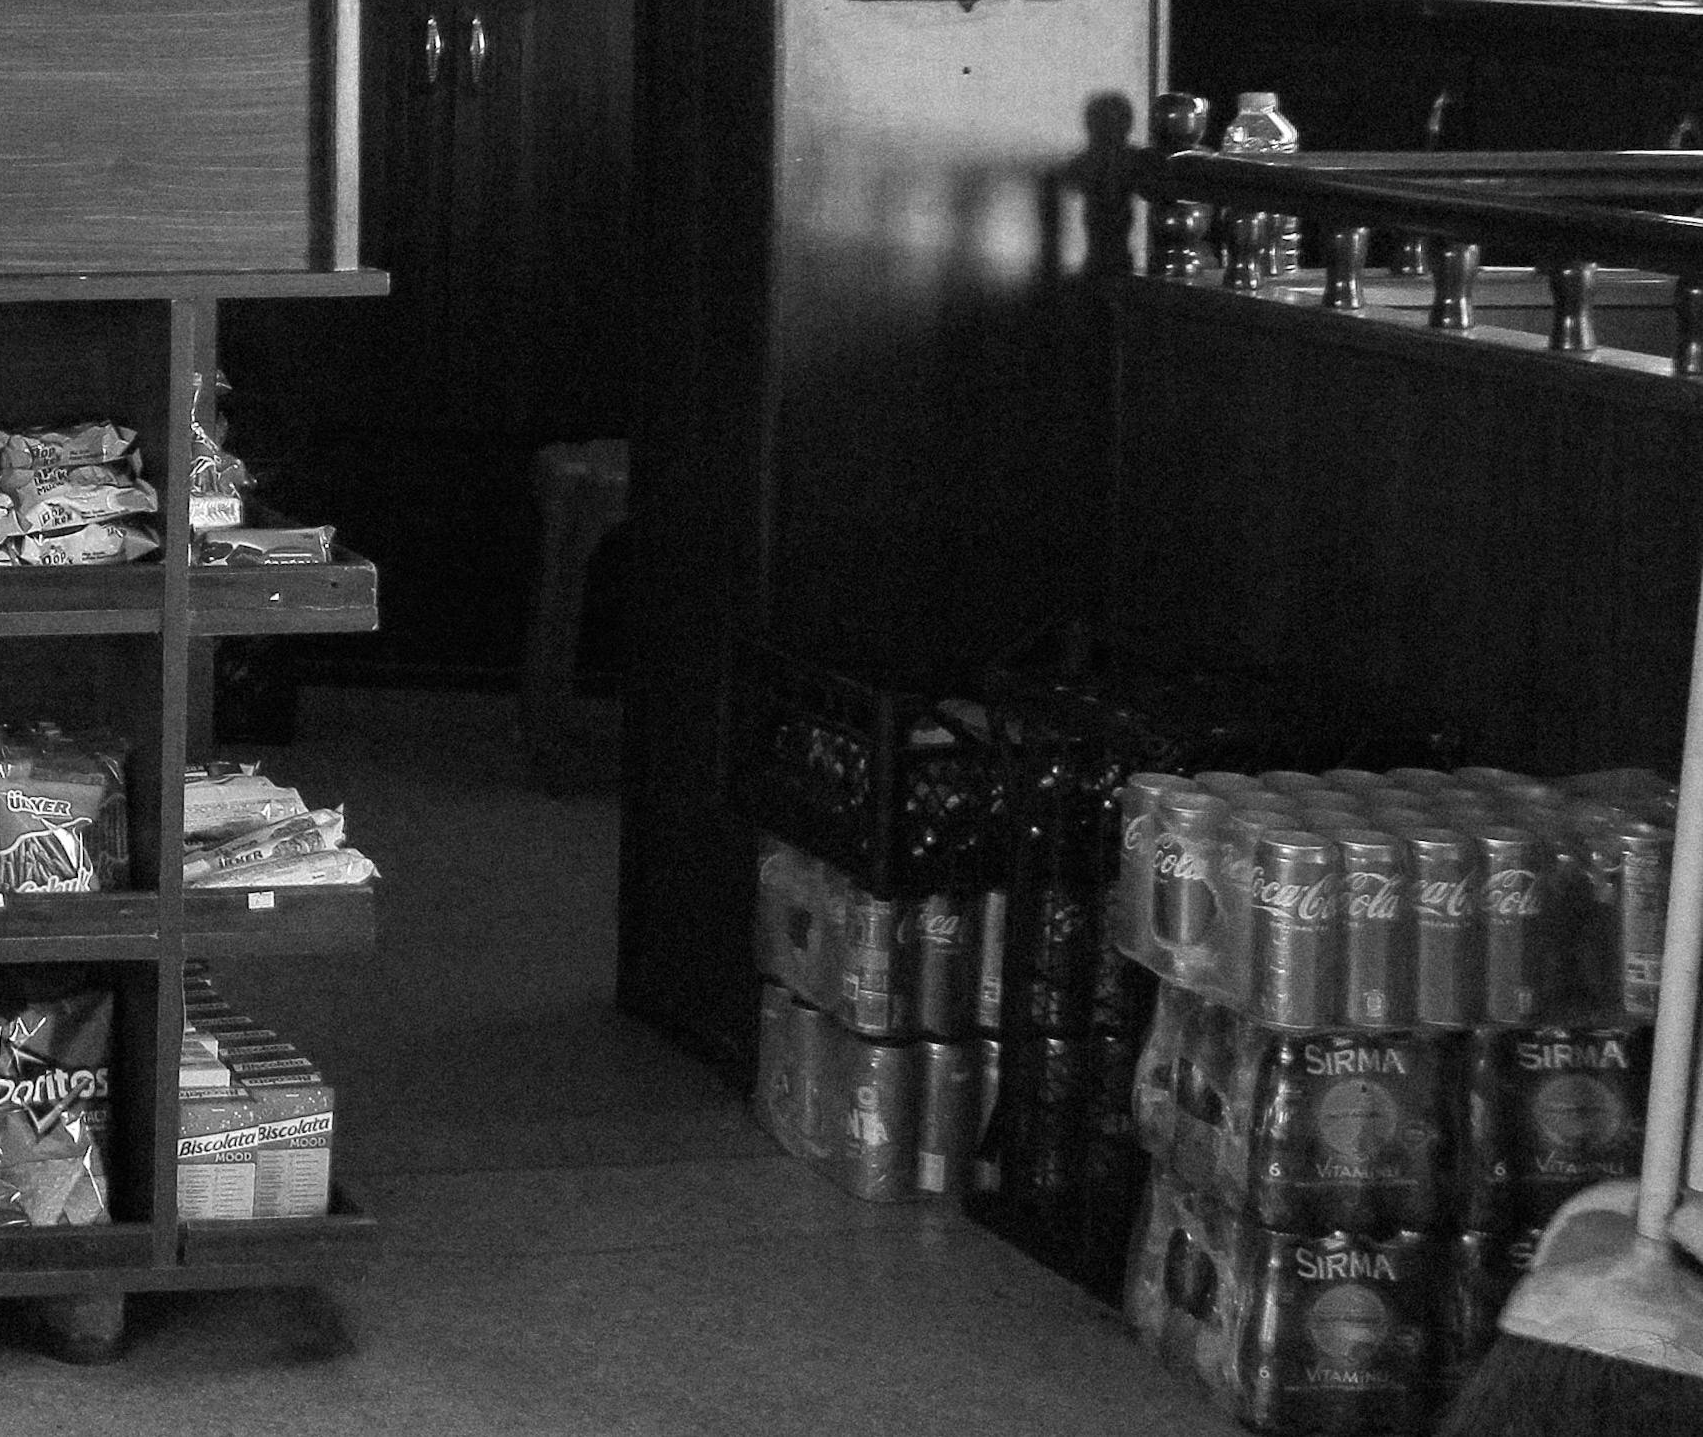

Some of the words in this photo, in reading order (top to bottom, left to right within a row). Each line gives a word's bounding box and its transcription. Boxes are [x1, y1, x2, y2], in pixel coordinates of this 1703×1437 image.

[1304, 1043, 1406, 1076] SIRMA
[1517, 1040, 1627, 1069] SIRMA
[258, 1116, 330, 1142] Biscolata
[179, 1132, 256, 1157] Biscolata
[289, 1137, 327, 1148] MOOD
[214, 1151, 253, 1163] MOOD
[1268, 1163, 1281, 1178] 6
[1296, 1247, 1396, 1281] SIRMA
